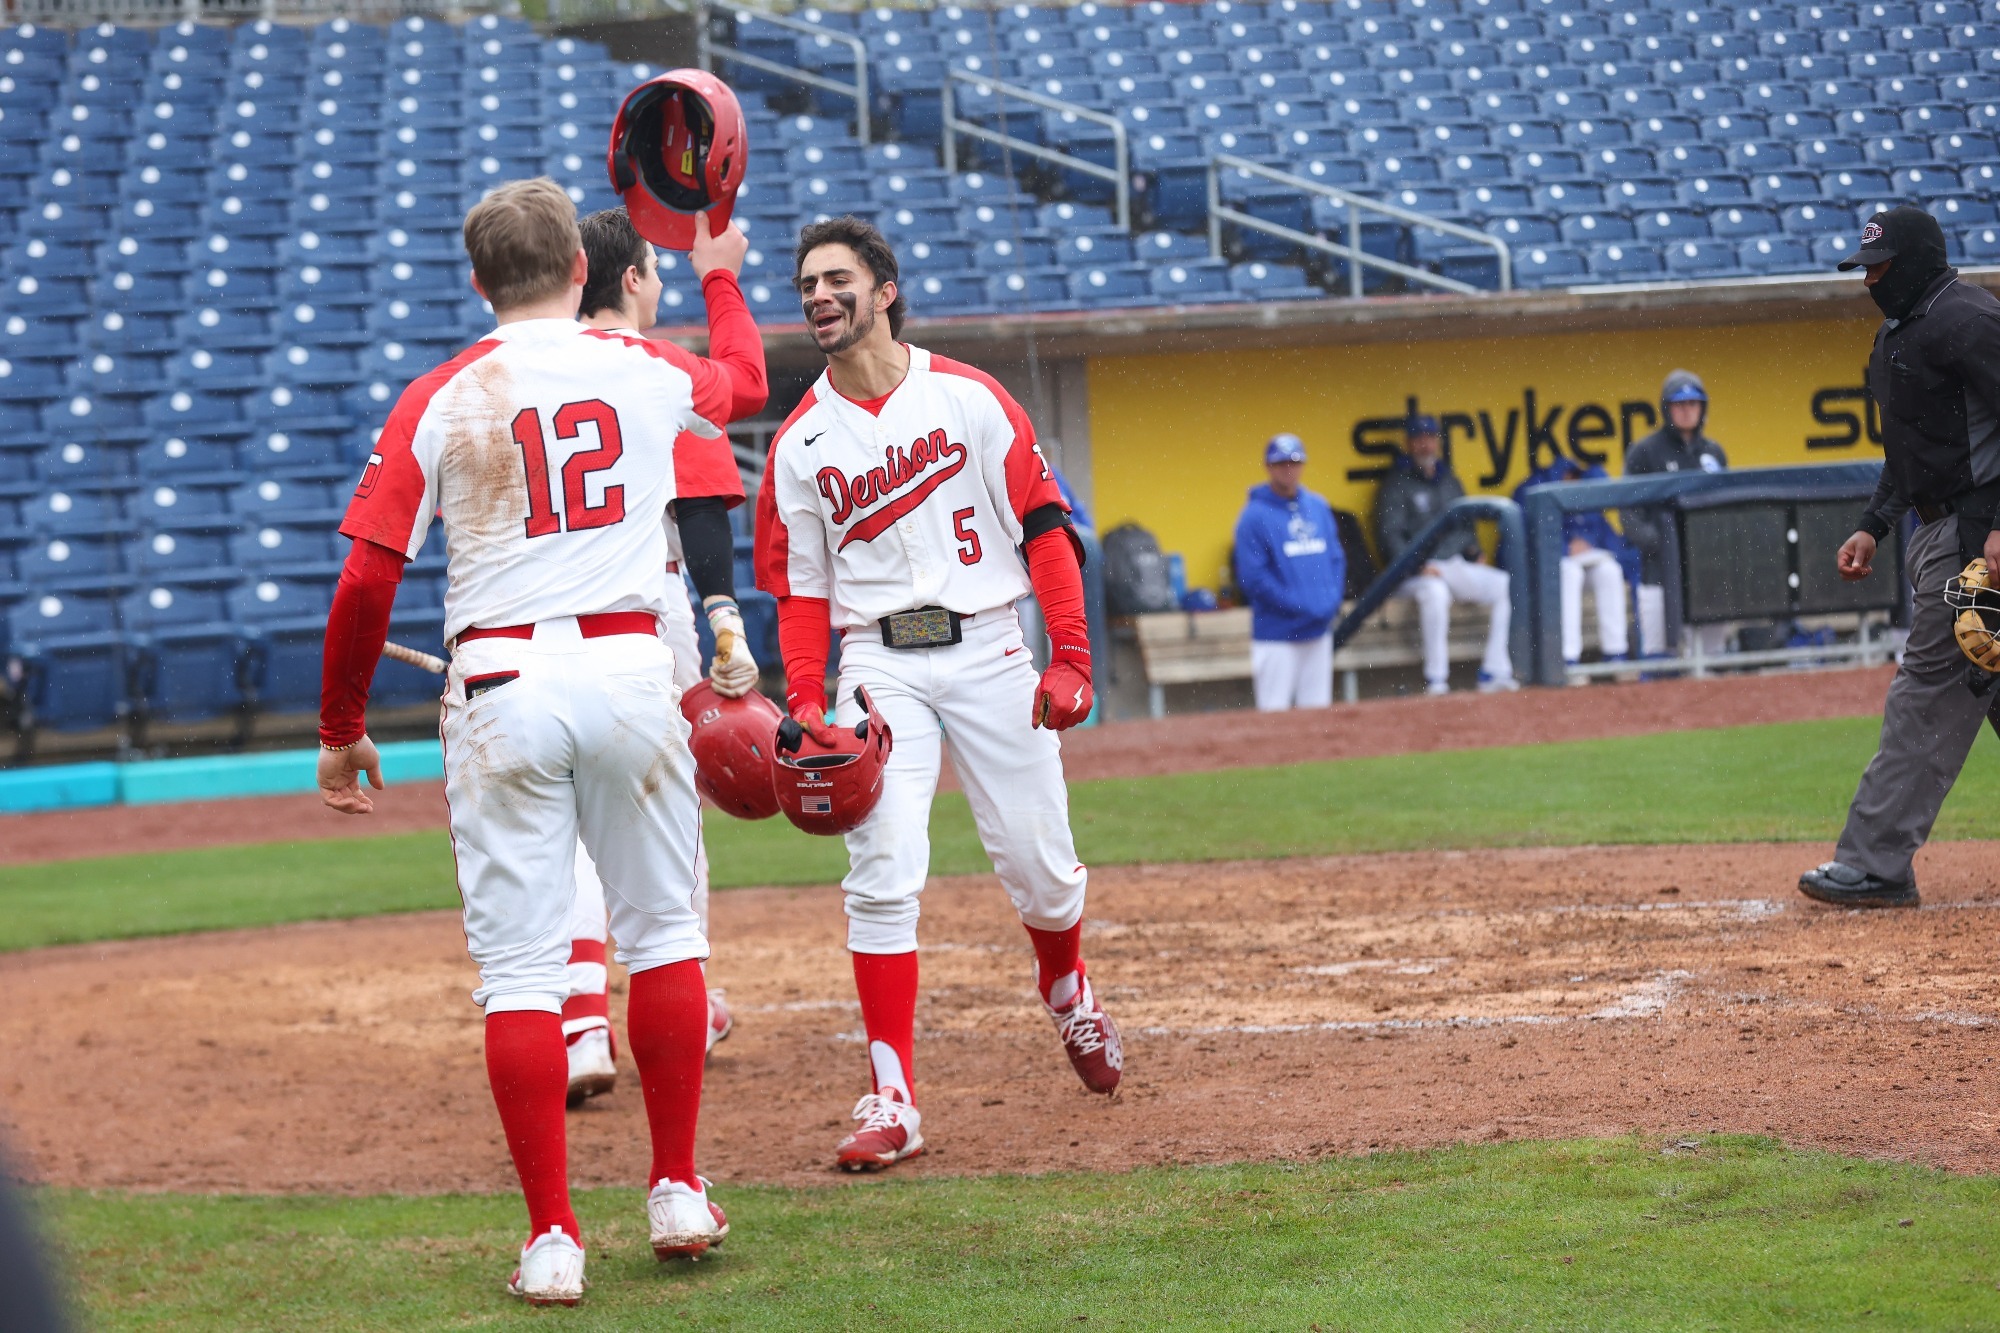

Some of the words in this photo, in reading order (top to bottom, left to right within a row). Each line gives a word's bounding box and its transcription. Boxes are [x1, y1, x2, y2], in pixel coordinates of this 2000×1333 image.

[510, 398, 626, 539] 12
[816, 427, 967, 525] Denison
[952, 505, 983, 567] 5
